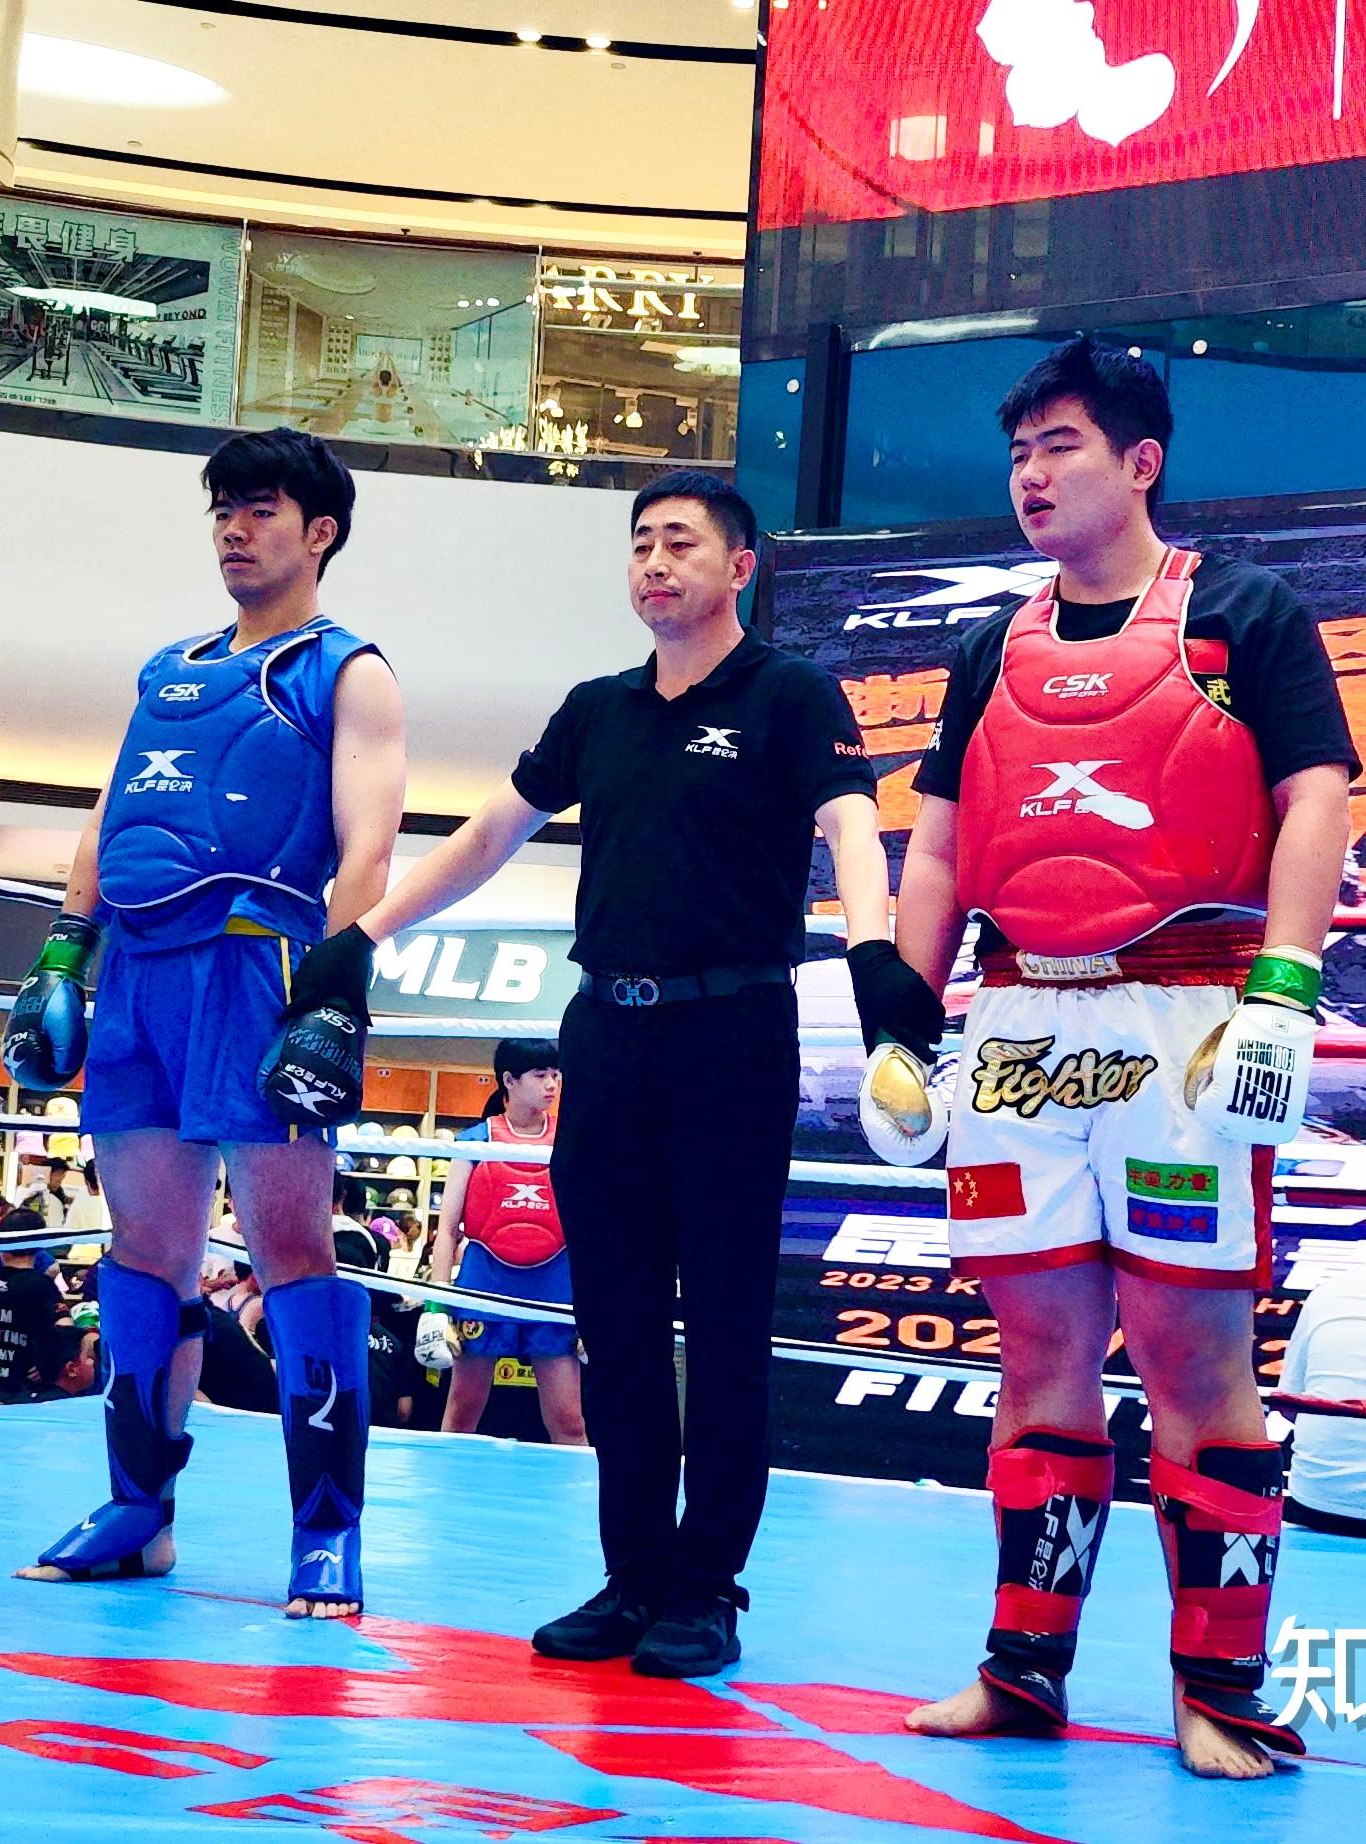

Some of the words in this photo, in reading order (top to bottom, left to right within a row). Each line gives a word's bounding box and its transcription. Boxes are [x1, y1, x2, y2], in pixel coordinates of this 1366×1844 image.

[158, 683, 207, 698] CSK
[1042, 672, 1114, 694] CSK
[370, 933, 549, 1004] MLB
[971, 1035, 1158, 1118] Fighter
[819, 1270, 933, 1293] 2023
[835, 1309, 1002, 1356] 202
